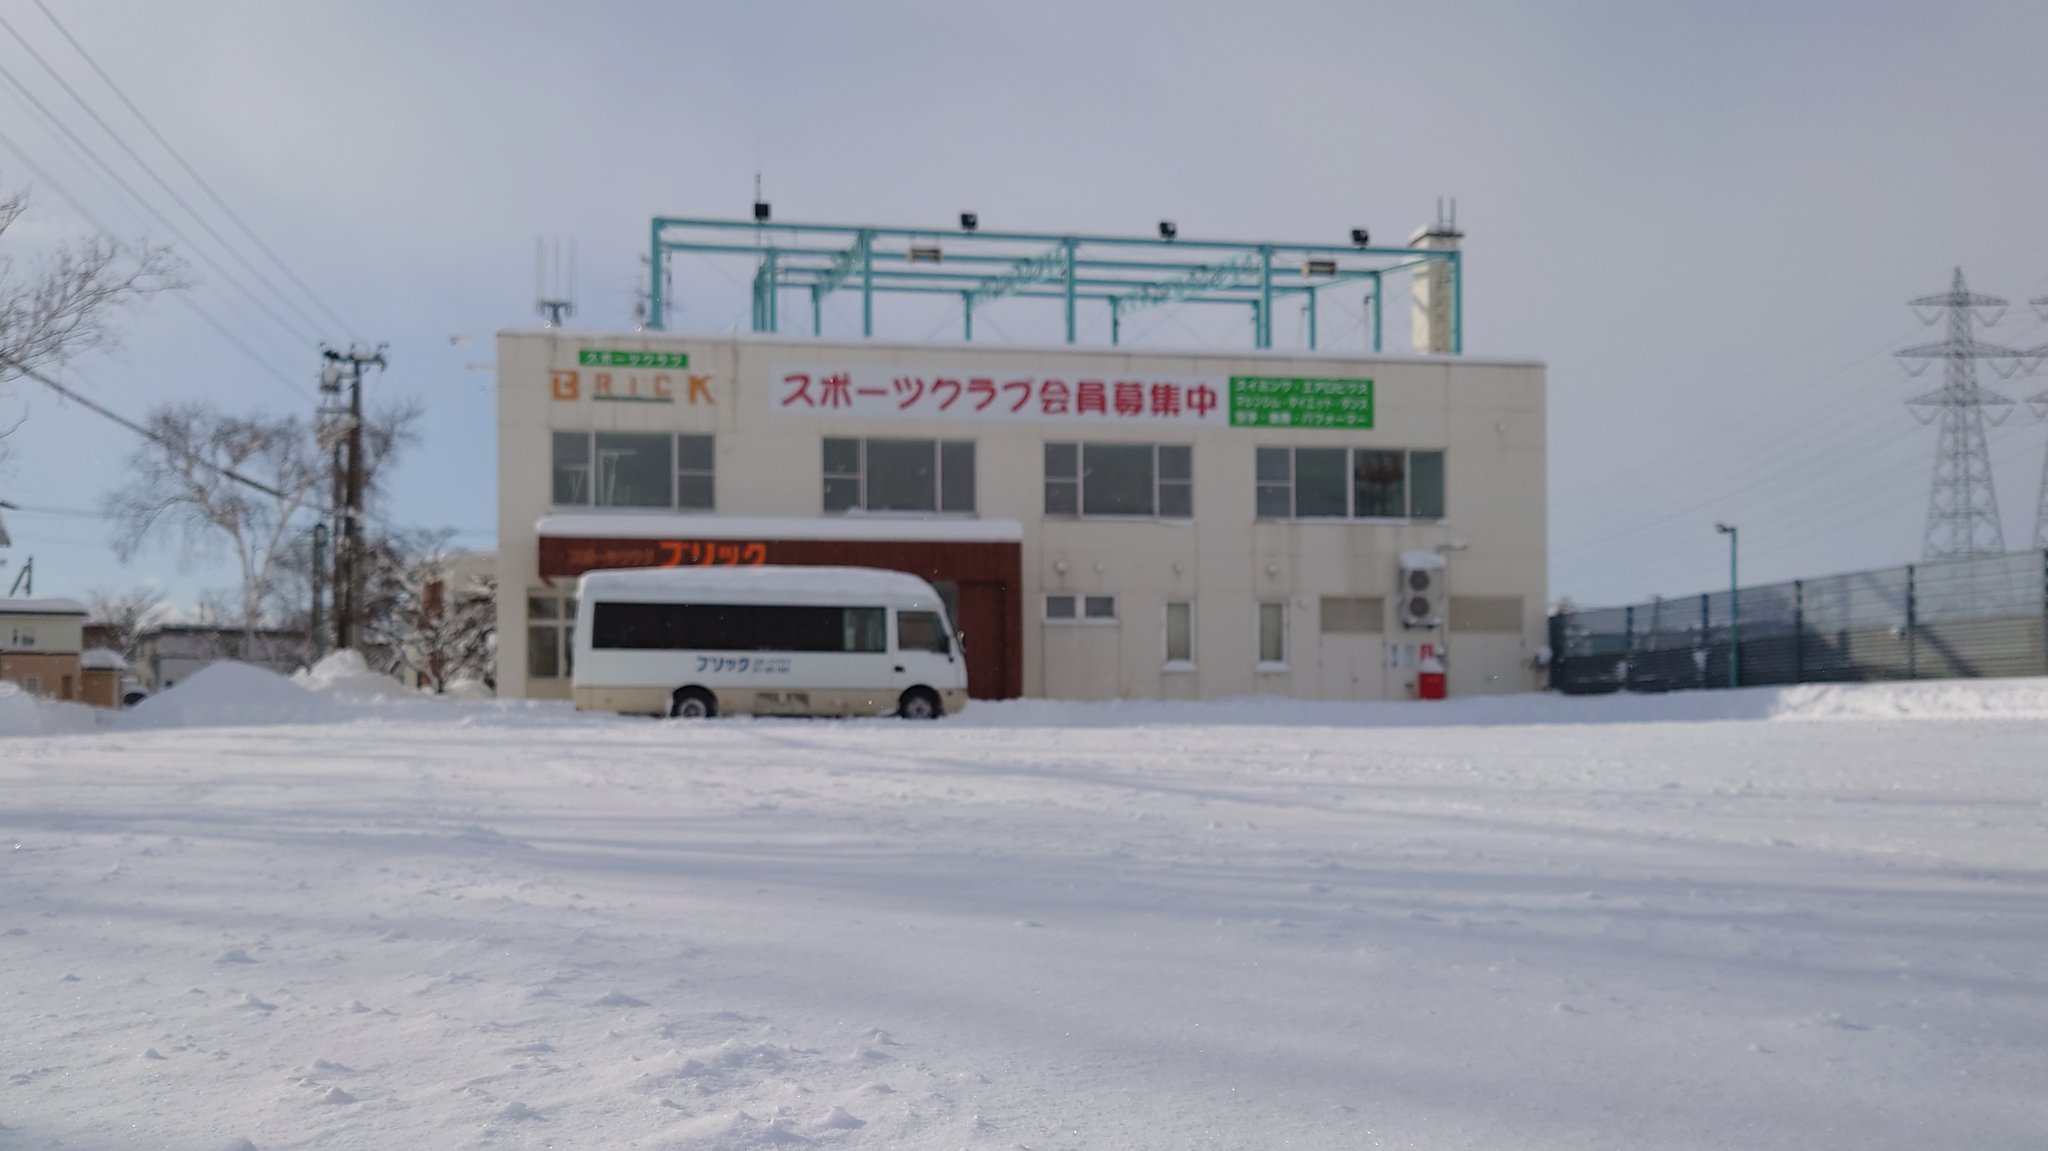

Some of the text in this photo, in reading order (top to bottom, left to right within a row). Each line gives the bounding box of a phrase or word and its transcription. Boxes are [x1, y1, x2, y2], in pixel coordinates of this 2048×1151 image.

[781, 373, 1218, 418] スポーツクラブ会員募集中
[659, 541, 767, 569] ブリック
